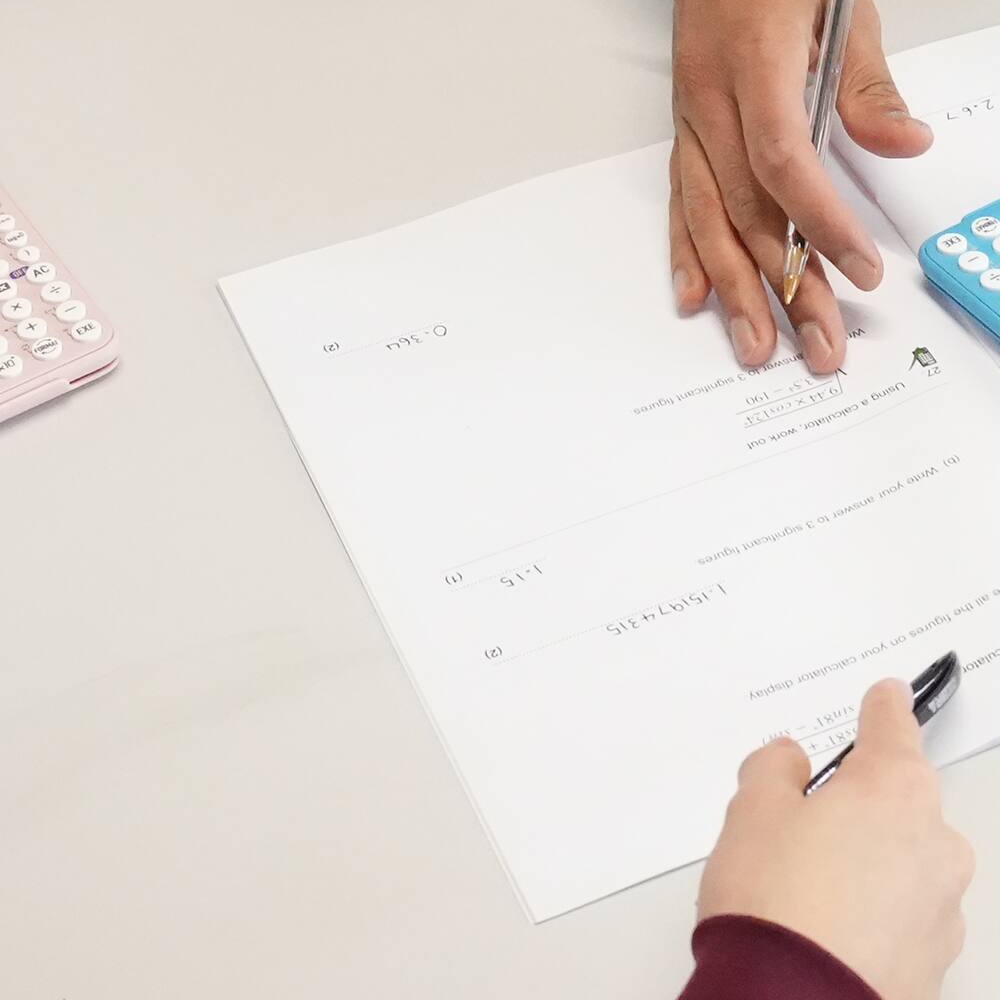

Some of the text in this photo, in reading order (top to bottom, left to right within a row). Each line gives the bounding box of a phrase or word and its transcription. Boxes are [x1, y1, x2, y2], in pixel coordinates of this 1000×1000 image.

[944, 232, 962, 248] EXE
[34, 266, 50, 278] AC
[76, 324, 94, 336] EXE
[322, 342, 340, 352] (2)
[736, 368, 746, 382] 3
[676, 376, 734, 402] significant
[870, 382, 906, 400] Using
[768, 428, 798, 442] work
[746, 438, 766, 450] out
[942, 454, 960, 468] (b)
[906, 466, 938, 484] Write
[878, 480, 904, 498] your
[832, 496, 874, 518] answer
[806, 520, 816, 530] 3
[816, 516, 830, 524] to
[742, 526, 804, 550] significant
[444, 572, 462, 584] (1)
[974, 594, 990, 606] all
[954, 602, 974, 616] the
[908, 614, 952, 638] figures
[890, 634, 906, 646] on
[484, 646, 502, 660] (2)
[860, 642, 888, 660] your
[798, 656, 856, 684] calculator
